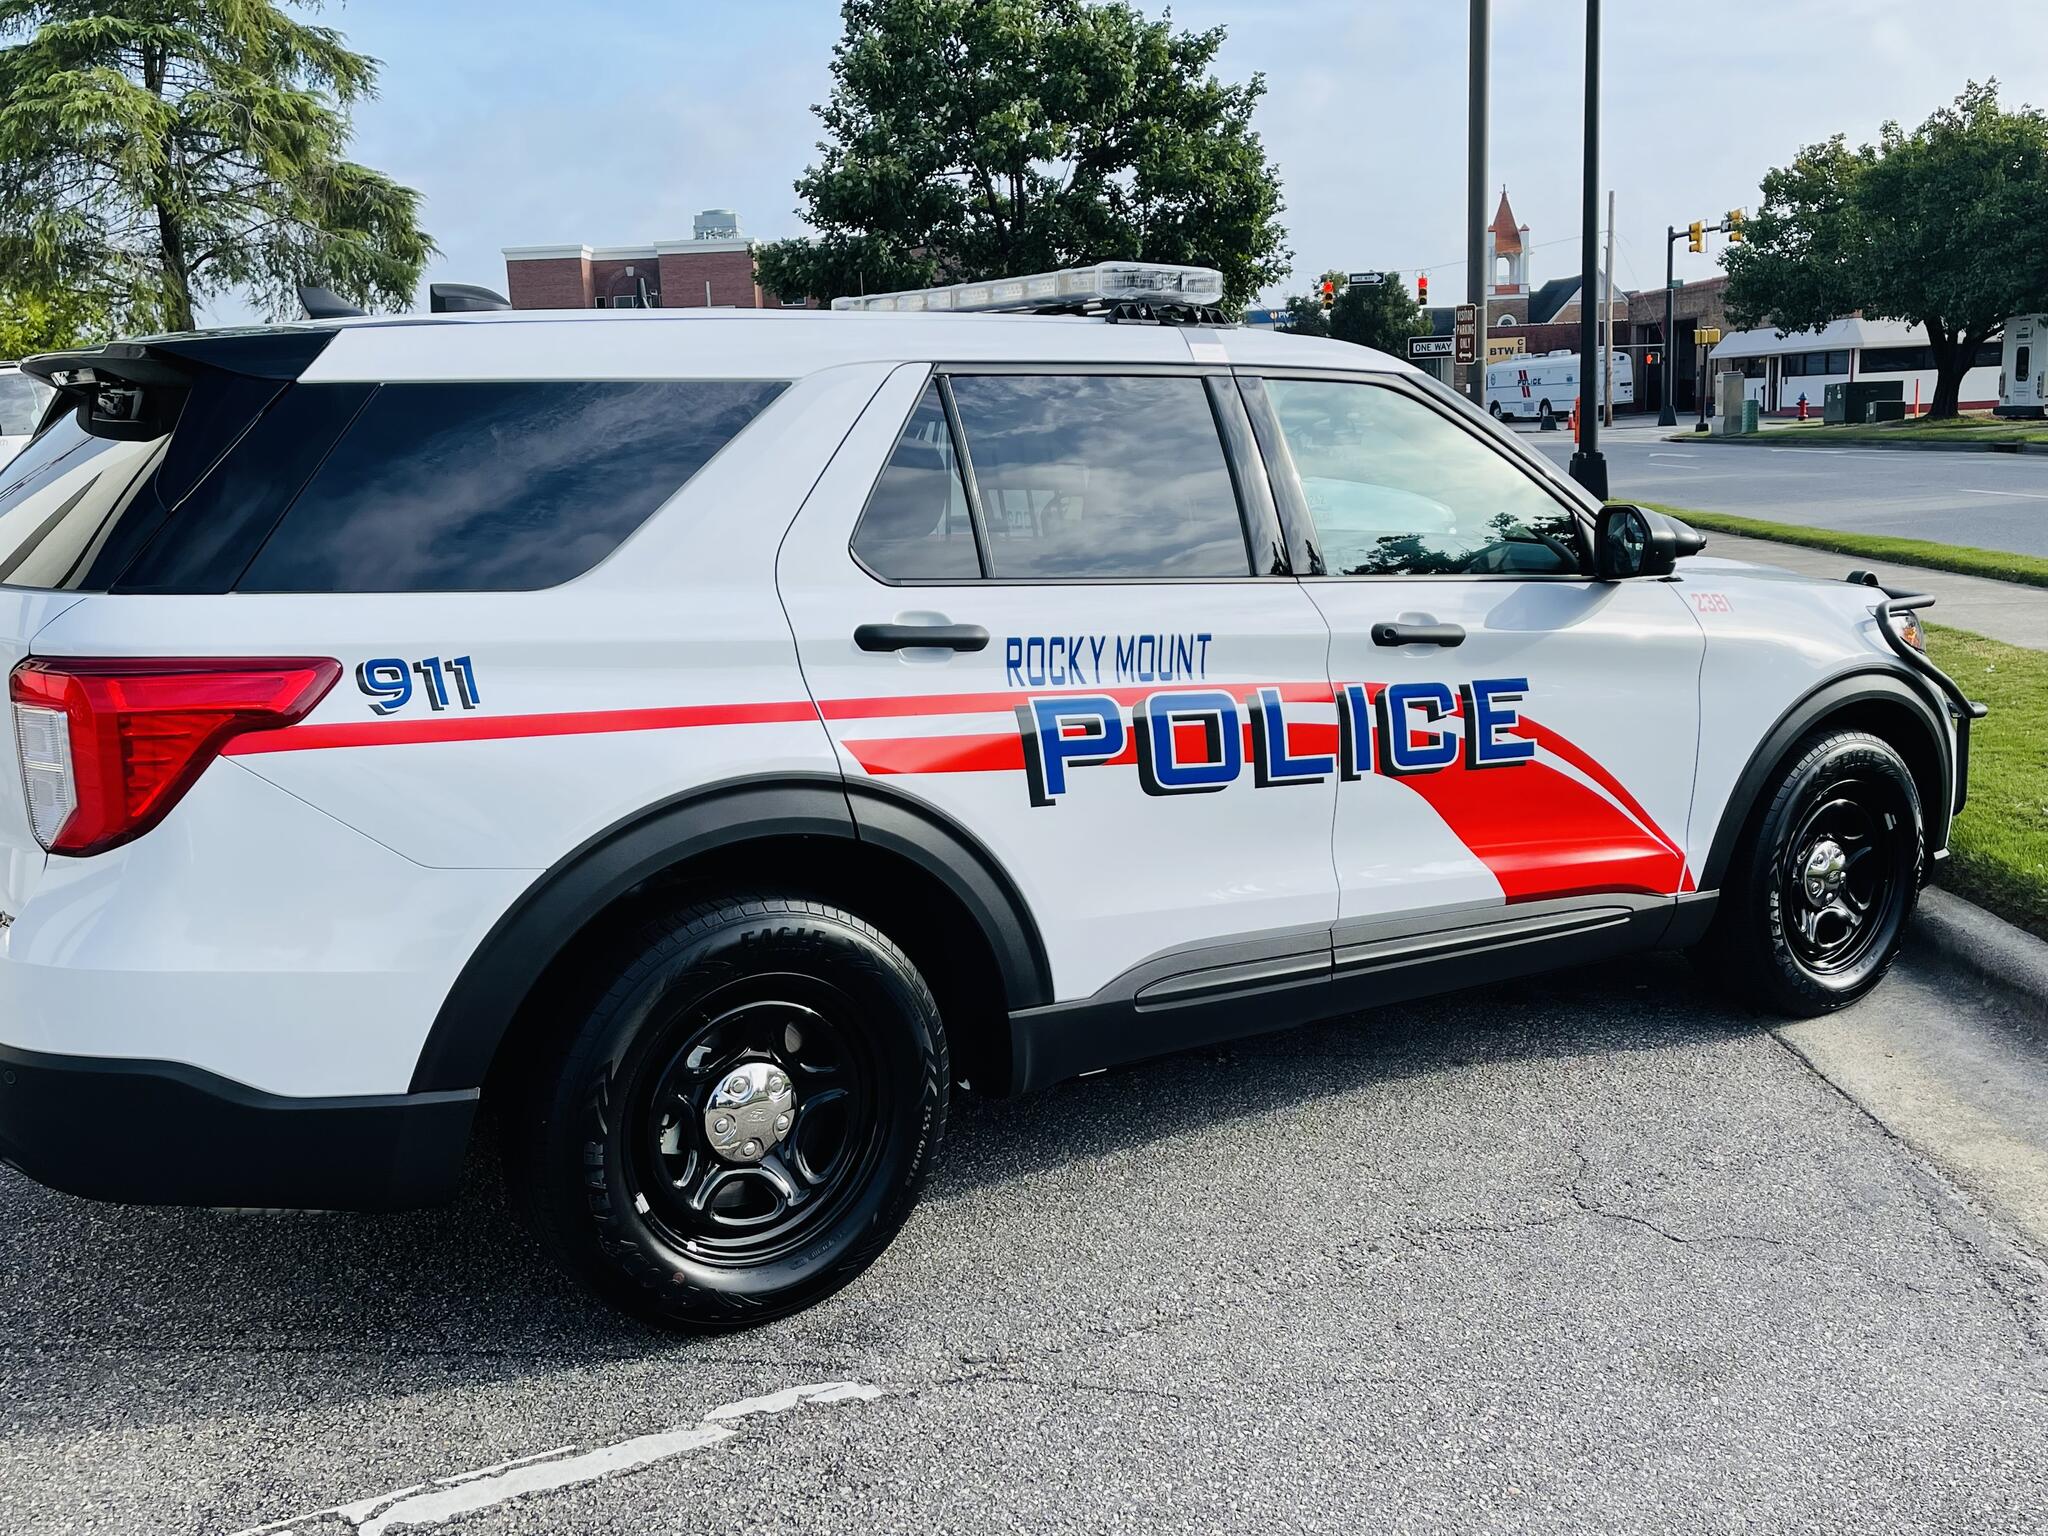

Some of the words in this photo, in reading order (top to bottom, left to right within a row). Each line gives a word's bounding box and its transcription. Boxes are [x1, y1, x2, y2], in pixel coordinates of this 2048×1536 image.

[1457, 323, 1474, 335] PARKING
[1415, 344, 1431, 352] ONE
[1434, 342, 1452, 351] WAY
[1460, 337, 1471, 349] ONLY
[1489, 346, 1515, 356] BTW
[1517, 377, 1542, 386] POLICE
[1005, 636, 1103, 688] ROCKY
[1114, 633, 1213, 682] MOUNT
[355, 655, 481, 716] 911
[1014, 677, 1538, 808] POLICE
[740, 926, 827, 948] EAGLE
